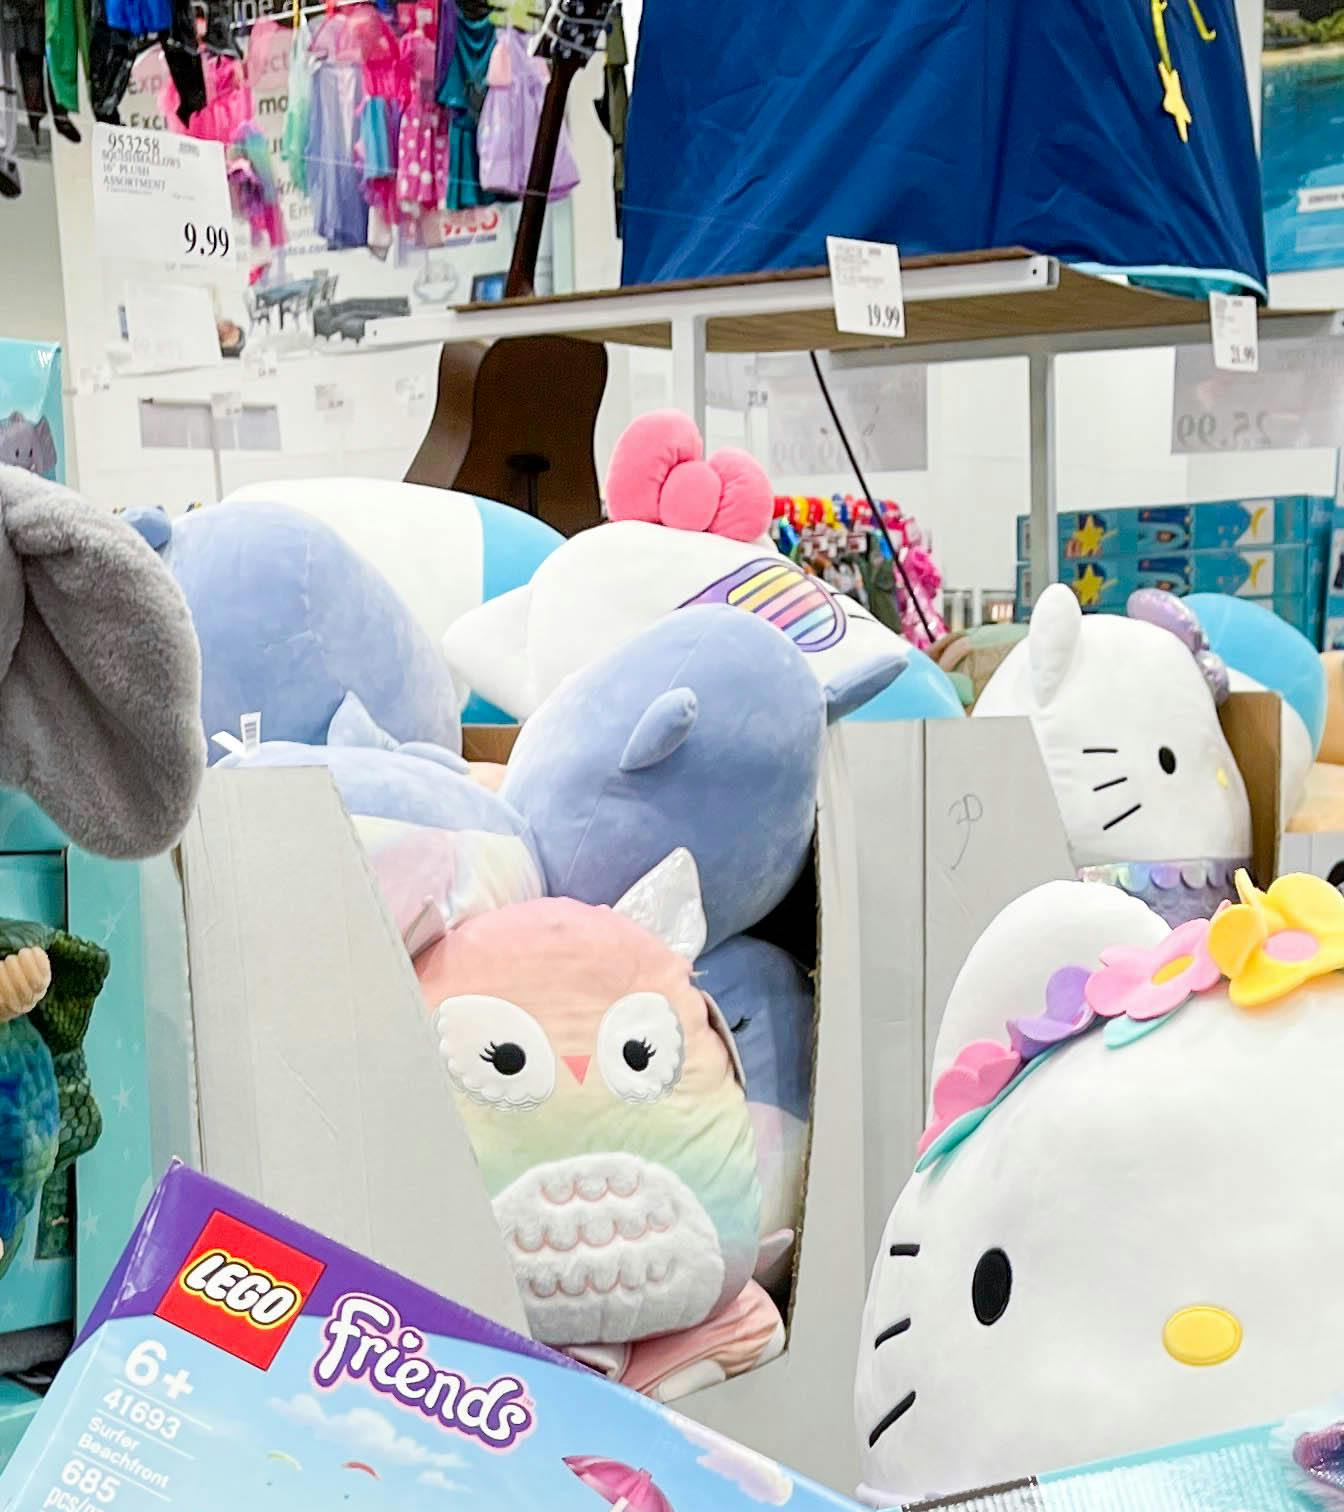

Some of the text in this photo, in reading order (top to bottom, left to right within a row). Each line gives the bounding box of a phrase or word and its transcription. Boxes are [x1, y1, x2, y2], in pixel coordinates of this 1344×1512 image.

[108, 134, 160, 155] 953258
[184, 222, 229, 256] 9.99
[868, 304, 900, 328] 19.99
[183, 1252, 298, 1326] LEGO
[125, 1340, 193, 1399] 6+
[316, 1296, 530, 1445] Friends
[89, 1417, 139, 1451] Surfer
[104, 1388, 181, 1439] 41693
[61, 1460, 120, 1502] 685
[79, 1434, 170, 1488] Beachfront
